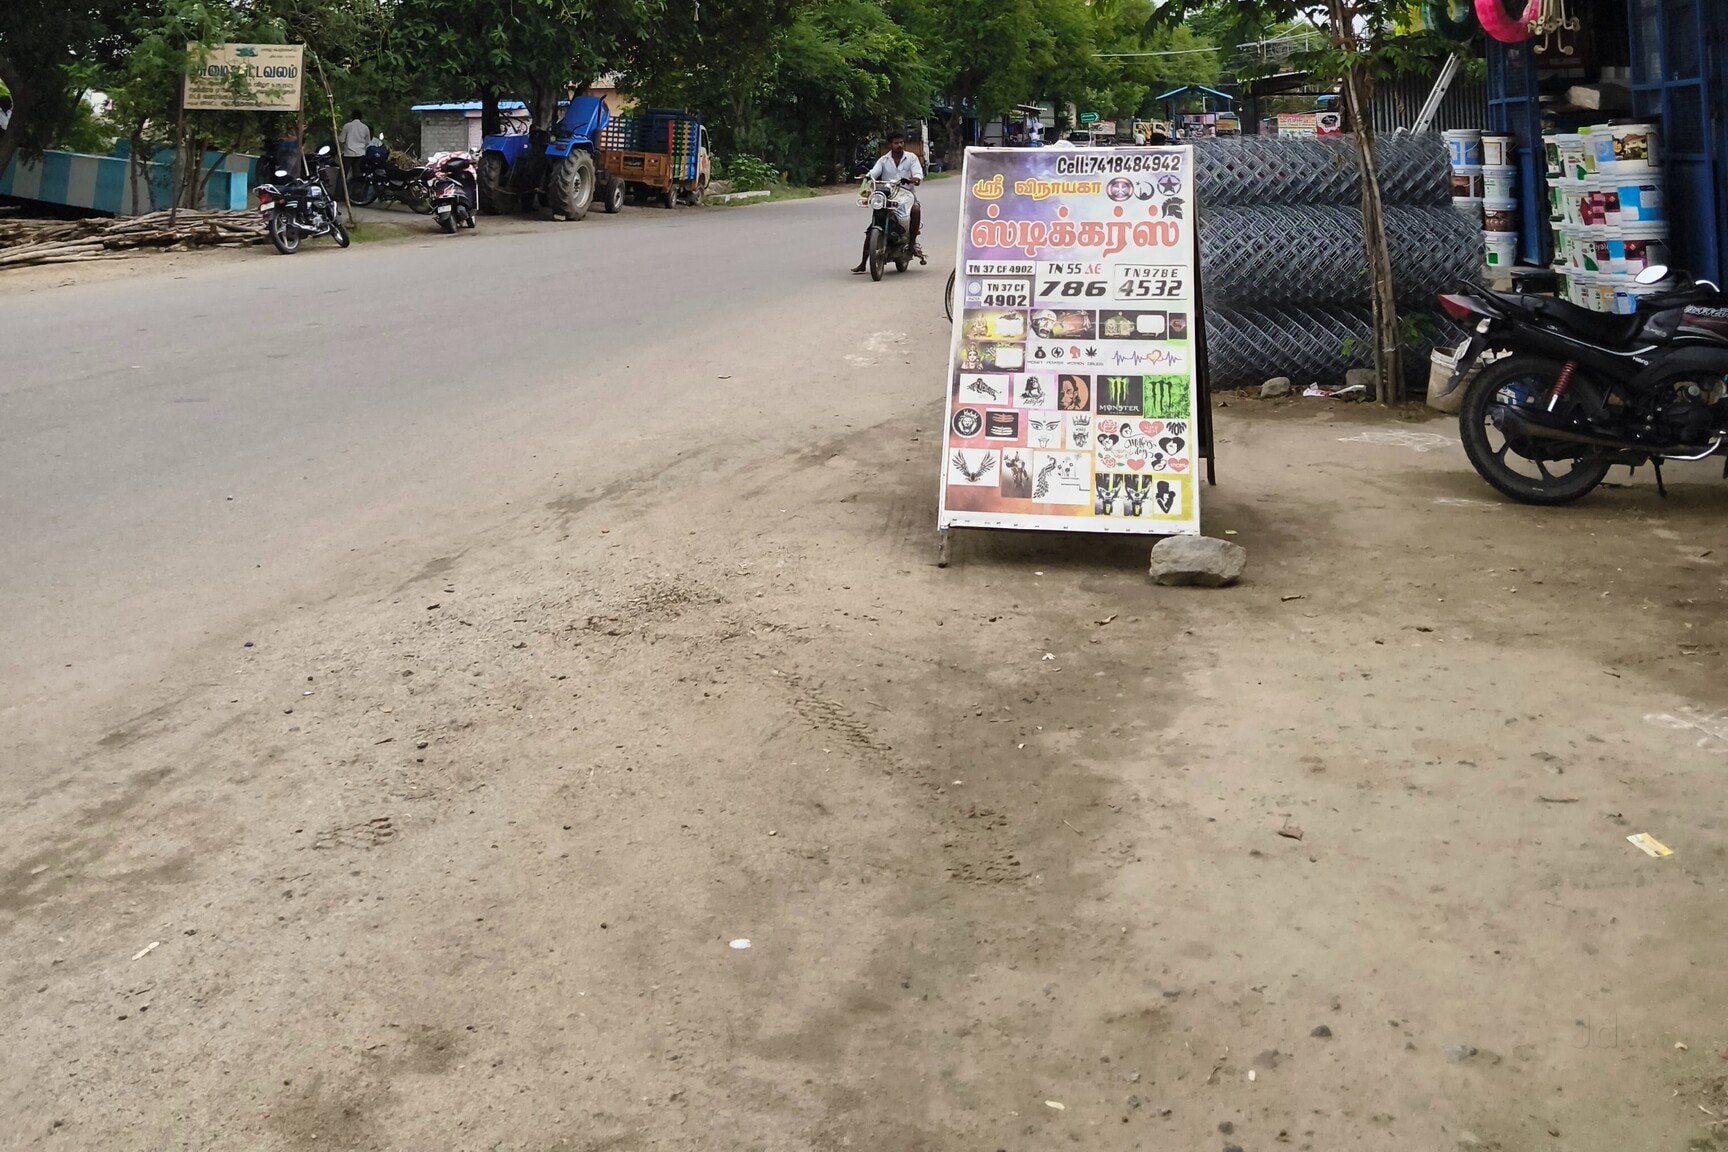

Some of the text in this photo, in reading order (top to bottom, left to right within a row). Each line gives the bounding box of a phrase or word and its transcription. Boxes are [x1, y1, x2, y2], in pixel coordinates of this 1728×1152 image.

[1057, 155, 1182, 175] Cell:7418484942
[973, 174, 1102, 200] ஸ்ரீ விநாயகா
[971, 204, 1180, 259] ஸ்டிக்கர்ஸ்
[969, 264, 1033, 274] TN 37 CF 4902
[1048, 263, 1064, 274] TN
[1066, 263, 1082, 274] 55
[987, 283, 1026, 292] TN 37 CF
[1039, 280, 1108, 297] 786
[1118, 279, 1183, 297] 4532
[983, 294, 1027, 307] 4902
[1099, 404, 1140, 412] MONSTER
